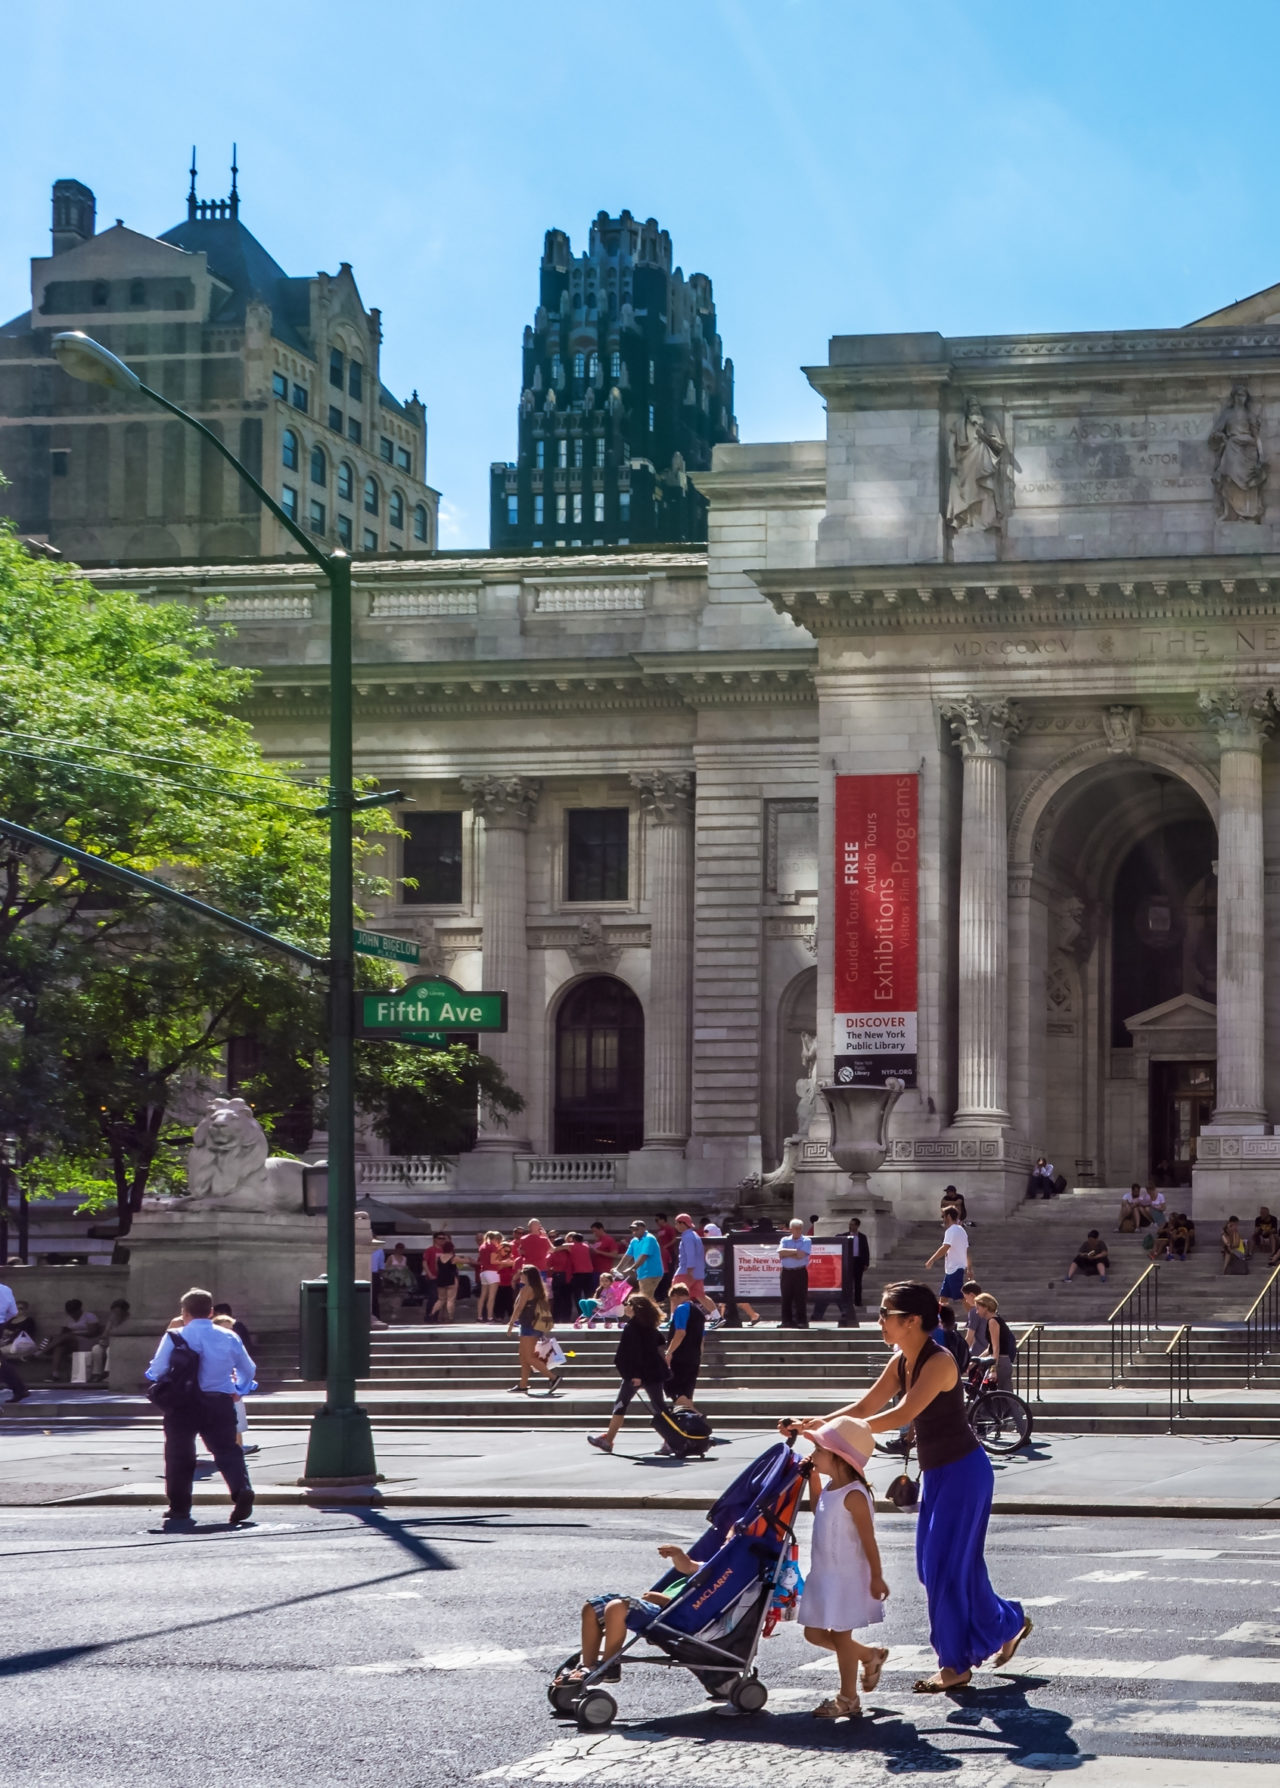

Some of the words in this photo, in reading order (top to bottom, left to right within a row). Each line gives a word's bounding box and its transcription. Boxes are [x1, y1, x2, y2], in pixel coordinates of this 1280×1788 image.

[1026, 425, 1057, 441] THE
[1068, 423, 1123, 439] ASTOR
[1129, 420, 1201, 437] LIBRARY
[1139, 454, 1178, 465] ASTOR
[953, 638, 1073, 657] MDCCCXCV
[1142, 630, 1209, 655] THE
[864, 812, 877, 849] Tours
[891, 777, 916, 873] Programs
[844, 842, 859, 885] FREE
[864, 853, 877, 893] Audio
[847, 889, 860, 926] Tours
[356, 933, 379, 948] JOHN
[382, 937, 418, 956] BIGELOW
[873, 878, 894, 1000] Exhibitions
[846, 932, 859, 982] Guided
[377, 1001, 430, 1022] Fifth
[439, 1003, 483, 1022] Ave
[846, 1017, 906, 1028] DISCOVER
[846, 1031, 862, 1040] The
[864, 1031, 883, 1039] New
[886, 1030, 906, 1039] York
[846, 1042, 873, 1050] Public
[874, 1041, 905, 1051] Library
[692, 1568, 733, 1610] MACLAREN
